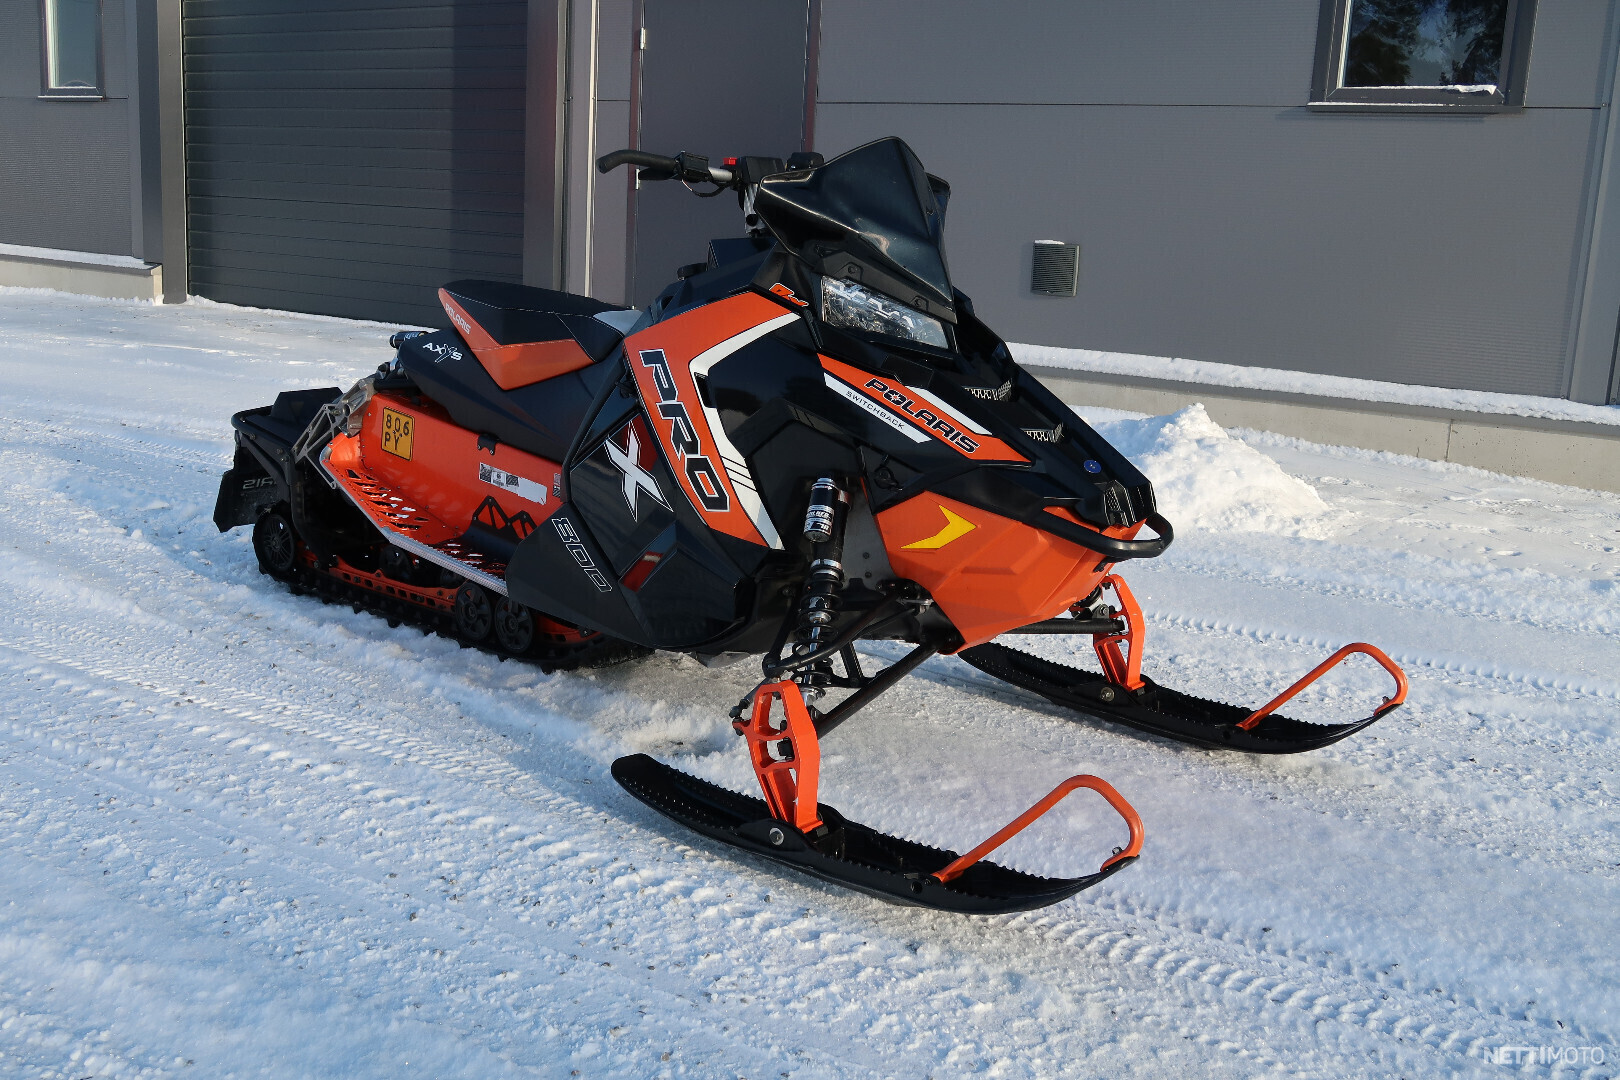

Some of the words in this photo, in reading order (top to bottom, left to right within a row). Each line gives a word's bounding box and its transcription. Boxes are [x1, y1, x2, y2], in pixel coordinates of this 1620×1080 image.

[445, 302, 472, 335] POLARIS
[385, 413, 410, 436] 806
[638, 348, 731, 512] PRO
[845, 390, 905, 430] SWITCHBACK
[864, 377, 981, 454] POLARIS
[384, 431, 401, 451] PY
[603, 419, 675, 523] X
[551, 517, 613, 593] 800
